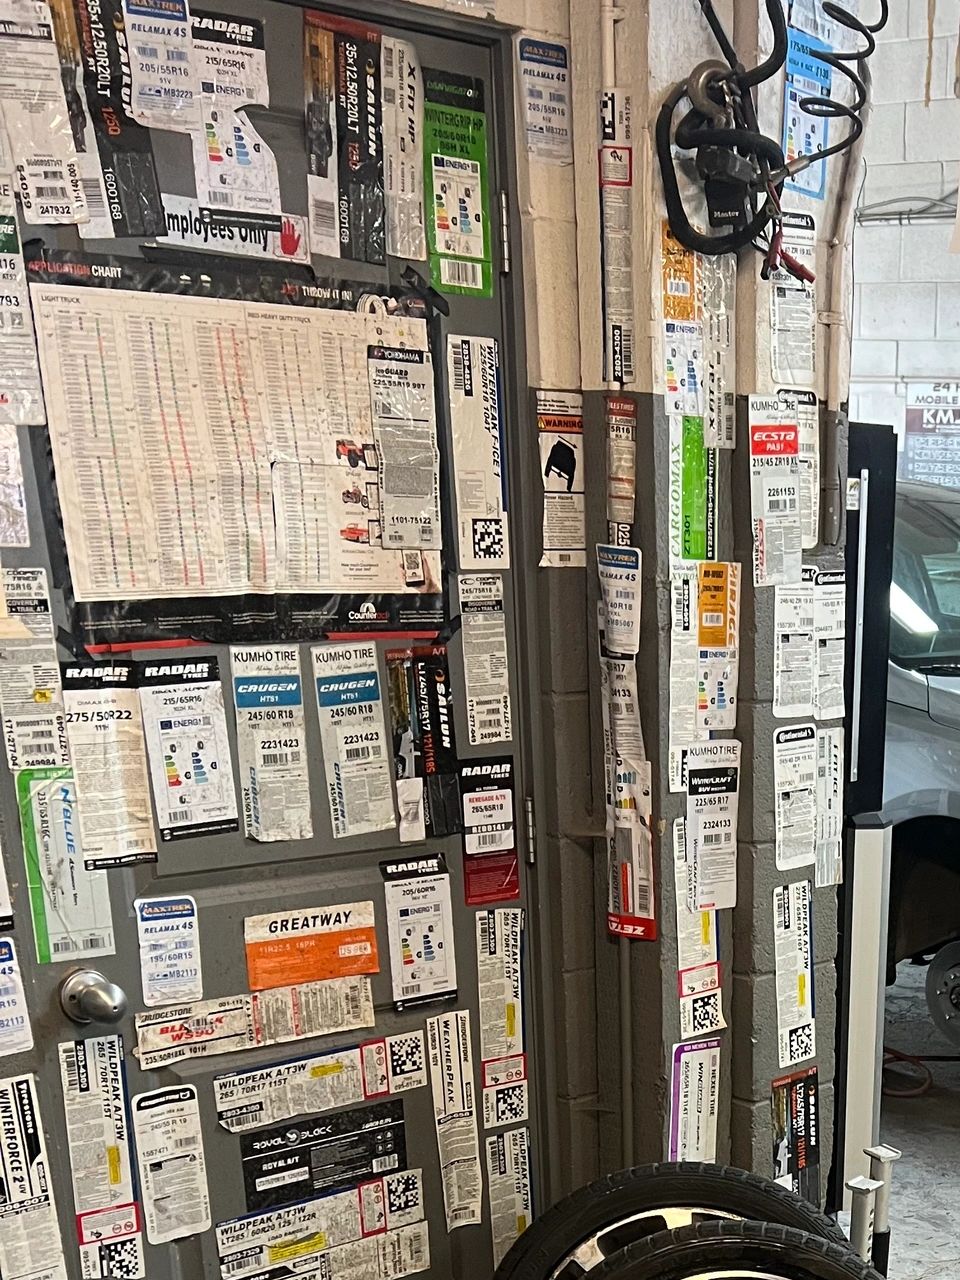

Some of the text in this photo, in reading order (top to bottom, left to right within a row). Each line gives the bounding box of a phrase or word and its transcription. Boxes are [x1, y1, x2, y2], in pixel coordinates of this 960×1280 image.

[131, 23, 187, 38] RELAMAX 4S
[139, 62, 190, 77] 205/55R16
[205, 55, 246, 70] 215/65R16
[555, 72, 567, 82] 4S
[163, 89, 193, 99] MB3223
[344, 42, 359, 134] 35x12.50R20LT
[406, 84, 416, 114] FIT
[365, 74, 378, 157] SAILUN
[425, 107, 484, 132] WINTERGRIP HP
[406, 117, 416, 144] HP
[103, 166, 123, 220] 1600168
[339, 194, 350, 243] 1600168
[163, 211, 235, 243] mployees
[28, 260, 122, 279] APPLICATION CHART
[302, 286, 330, 299] THROW
[332, 287, 339, 299] IT
[384, 350, 420, 362] YOKOHAMA
[613, 329, 622, 377] 2803-4300
[486, 346, 499, 434] WINTERPEAK
[933, 382, 951, 392] 24
[914, 395, 959, 406] MOBILE
[545, 418, 584, 430] WARNING
[753, 431, 796, 442] ECSTA
[752, 456, 799, 468] 215/45 ZR18 XL
[767, 487, 796, 497] 2261153
[670, 443, 681, 558] CARGOMAX
[683, 514, 691, 555] ZT301
[475, 576, 501, 586] COOPER
[624, 571, 637, 583] 4S
[234, 650, 297, 663] KUMHO TIRE
[315, 647, 375, 664] KUMHO TIRE
[65, 667, 131, 679] RADAR
[144, 663, 210, 678] RADAR
[182, 671, 209, 680] TYRES
[237, 682, 298, 694] CRUGEN
[319, 679, 376, 694] CRUGEN
[162, 694, 203, 707] 215/65R16
[66, 711, 133, 723] 275/50R22
[248, 709, 294, 722] 245/60 R18
[330, 704, 374, 719] 245/60 R18
[435, 682, 451, 749] SAILUN
[260, 738, 299, 749] 2231423
[343, 731, 380, 745] 2231423
[689, 744, 738, 757] KUMHO TIRE
[461, 763, 511, 777] RADAR
[694, 795, 730, 808] 225/65 R17
[702, 819, 731, 830] 2324133
[386, 859, 440, 875] RADAR
[402, 886, 437, 897] 205/60R16
[143, 904, 193, 914] MAXTREK
[144, 921, 194, 935] RELAMAX 4S
[268, 910, 353, 934] GREATWAY
[801, 884, 810, 971] WILDPEAK A/T3W
[150, 951, 193, 964] 195/60R15
[509, 911, 520, 1000] WILDPEAK A/T3W
[188, 1044, 208, 1055] 101H
[442, 1019, 456, 1104] WEATHERPEAK
[218, 1063, 308, 1091] WILDPEAK A/T3W
[104, 1041, 125, 1141] WILDPEAK A/T3W
[219, 1077, 288, 1100] 265 70R17 115T
[709, 1069, 718, 1117] NEXEN TIRE
[17, 1081, 34, 1135] Firestone
[808, 1095, 817, 1147] SAILUN
[261, 1158, 286, 1171] ROYAL
[13, 1174, 25, 1185] 2
[220, 1206, 306, 1236] WILDPEAK A/T3W
[221, 1234, 245, 1246] LT285
[251, 1226, 276, 1238] 60R20
[297, 1212, 317, 1224] 122R
